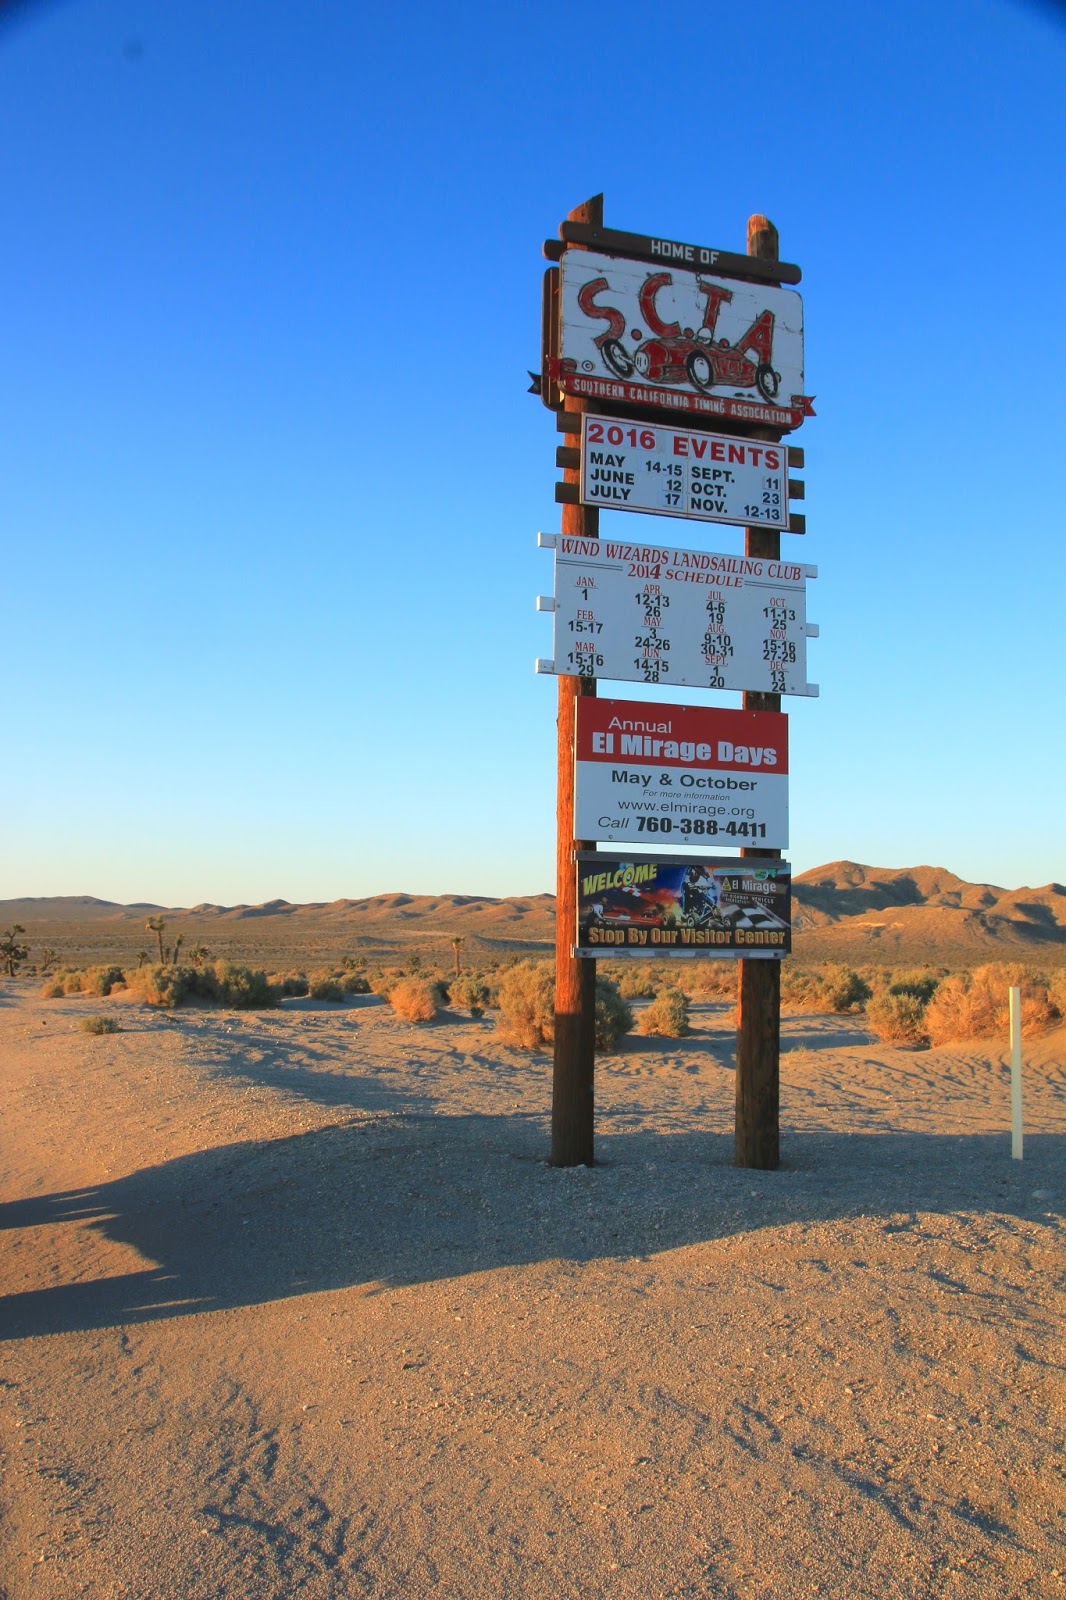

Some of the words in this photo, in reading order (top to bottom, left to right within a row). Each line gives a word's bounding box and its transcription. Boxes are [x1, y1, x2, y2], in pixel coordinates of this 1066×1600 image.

[651, 240, 694, 262] HOME
[700, 249, 719, 265] OF
[574, 379, 624, 398] SOUTHERN
[630, 388, 688, 407] CALIFORNIA
[694, 397, 725, 413] TIMING
[731, 404, 792, 423] ASSOCIATION
[588, 423, 655, 449] 2016
[673, 436, 780, 470] EVENTS
[590, 452, 626, 467] MAY
[645, 461, 682, 476] 14-15
[590, 468, 634, 485] JUNE
[666, 480, 682, 492] 12
[691, 466, 735, 483] SEPT.
[766, 478, 780, 490] 11
[590, 485, 631, 501] JULY
[665, 493, 680, 505] 17
[691, 482, 727, 498] OCT.
[763, 492, 780, 504] 23
[691, 498, 728, 514] NOV.
[744, 505, 780, 520] 12-13
[561, 539, 600, 557] WIND
[606, 544, 669, 564] WIZARDS
[673, 552, 762, 576] LANDSAILING
[768, 564, 802, 581] CLUB
[627, 563, 661, 580] 2014
[665, 569, 743, 588] SCHEDULE
[581, 588, 588, 600] 1
[635, 593, 670, 608] 12-13
[645, 605, 661, 618] 26
[706, 601, 725, 614] 4-6
[763, 607, 796, 621] 11-13
[643, 616, 662, 627] MAY
[708, 612, 723, 625] 19
[772, 619, 787, 631] 25
[568, 620, 603, 634] 15-17
[649, 627, 657, 640] 3
[635, 636, 670, 651] 24-26
[704, 633, 731, 647] 9-10
[763, 639, 796, 654] 15-16
[701, 643, 734, 657] 30-31
[763, 650, 796, 663] 27-29
[567, 652, 604, 666] 15-16
[634, 658, 669, 672] 14-15
[578, 664, 594, 677] 29
[644, 670, 660, 682] 28
[712, 666, 719, 677] 1
[770, 671, 785, 682] 13
[710, 676, 725, 688] 20
[771, 682, 787, 693] 24
[608, 716, 672, 734] Annual
[592, 731, 614, 754] El
[621, 734, 712, 762] Mirage
[717, 741, 778, 766] Days
[611, 770, 652, 787] May
[659, 773, 673, 786] &
[680, 774, 758, 791] October
[643, 789, 658, 798] For
[683, 792, 731, 801] information
[617, 801, 755, 819] www.elmirage.org
[598, 816, 630, 829] Call
[636, 816, 766, 838] 760-388-4411
[582, 863, 658, 896] WELCOME
[732, 880, 739, 890] El
[742, 880, 776, 894] Mirage
[589, 927, 625, 945] Stop
[628, 928, 647, 945] By
[651, 928, 678, 944] Our
[680, 928, 731, 944] Visitor
[735, 928, 785, 945] Center
